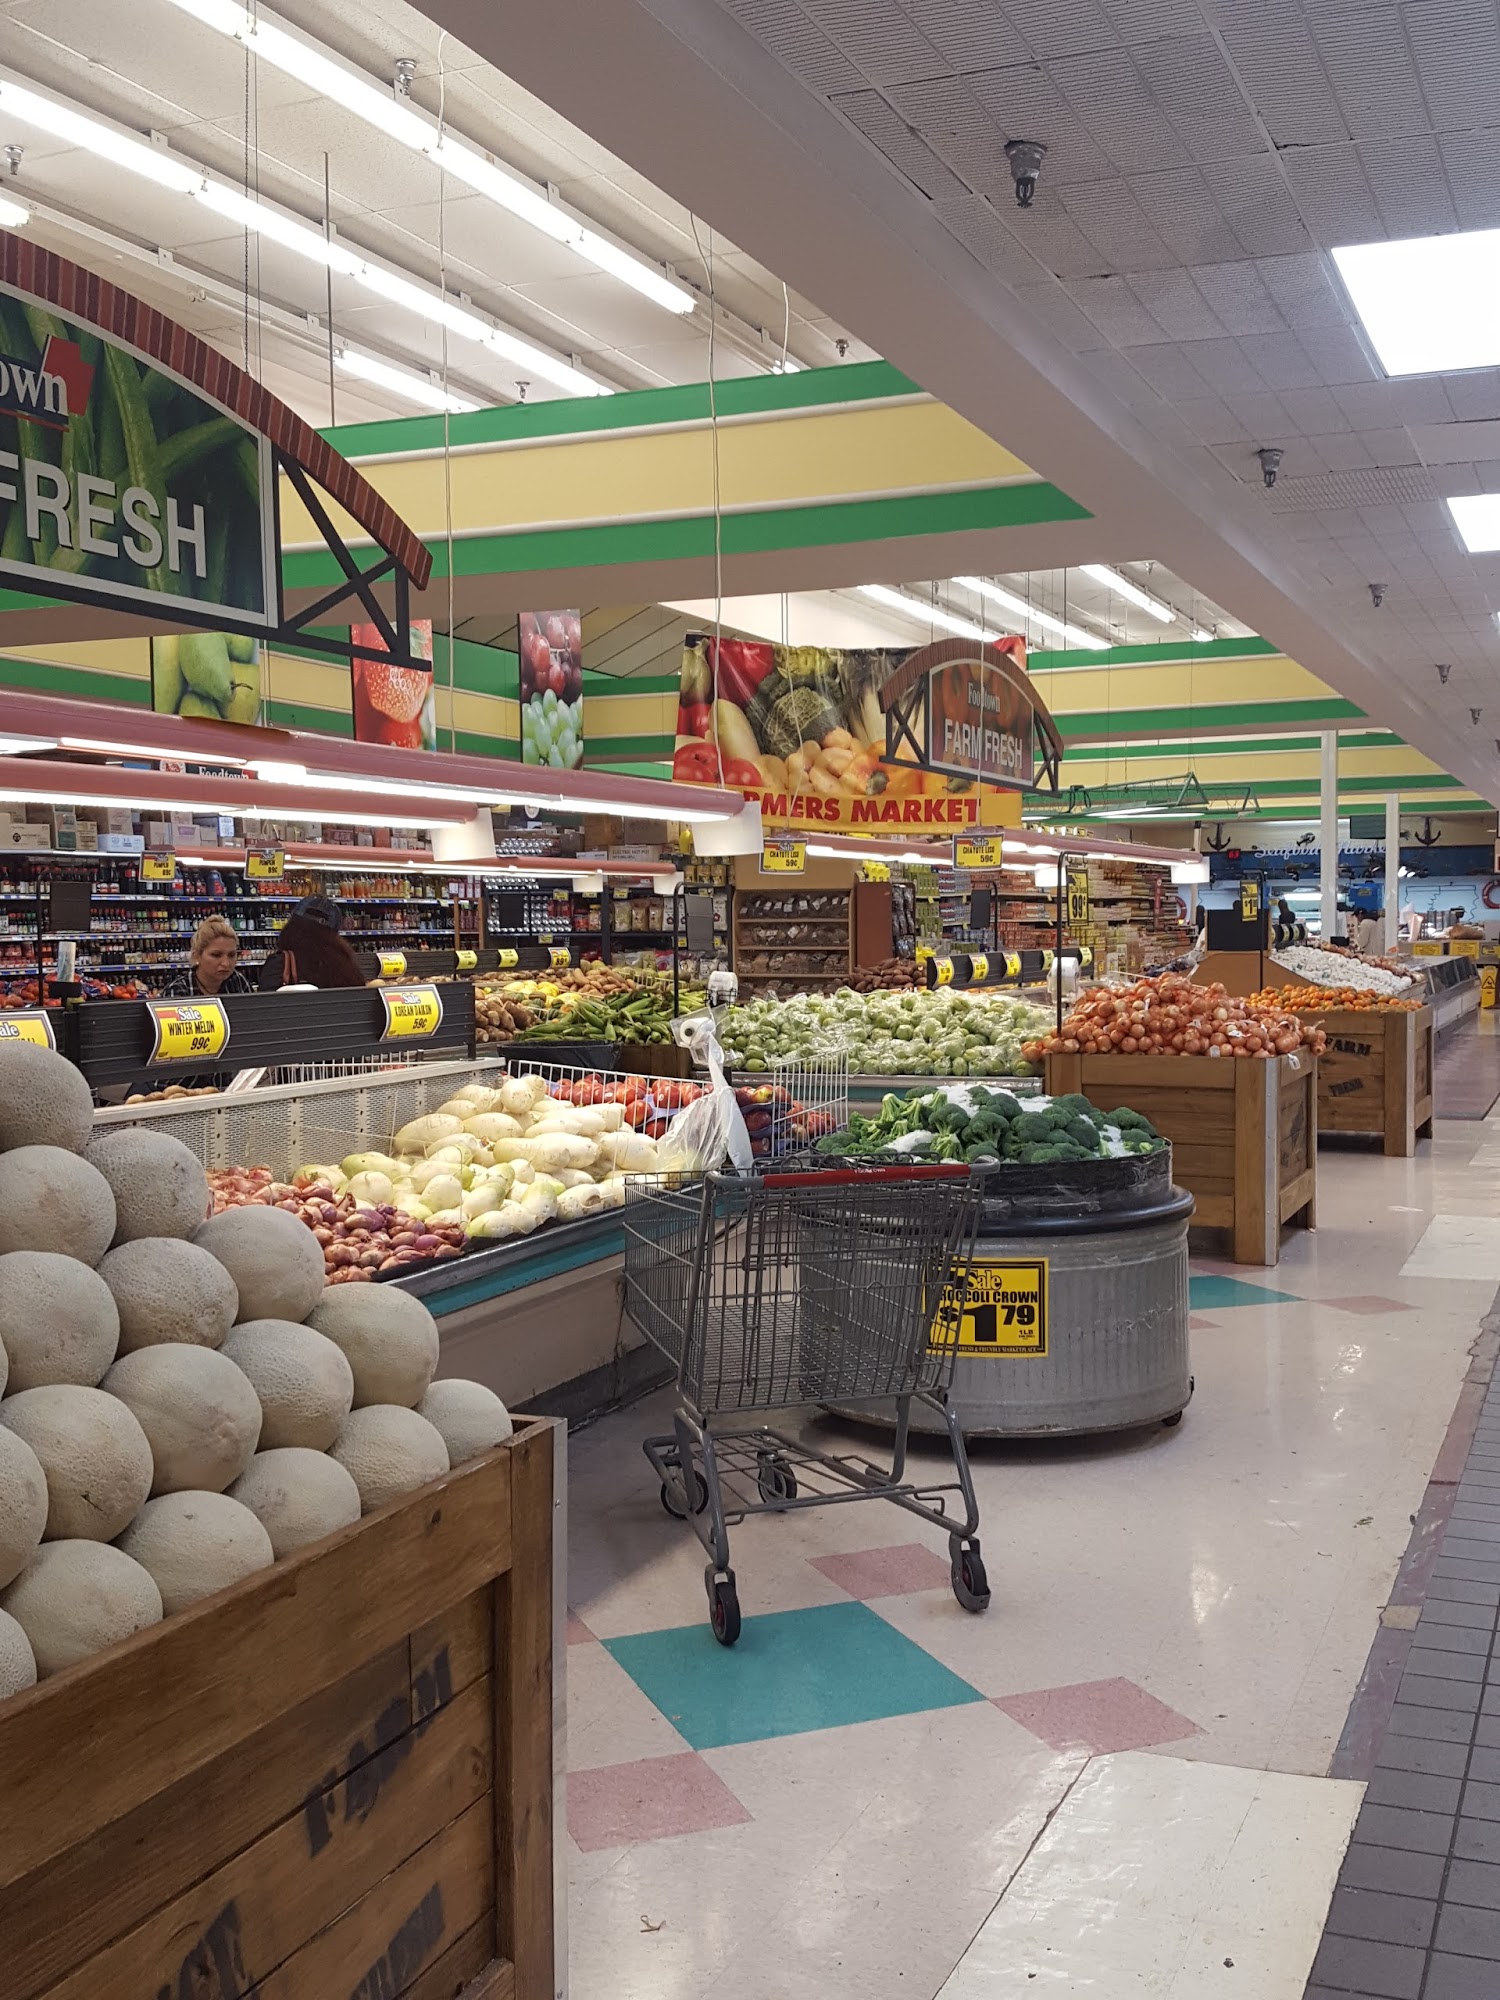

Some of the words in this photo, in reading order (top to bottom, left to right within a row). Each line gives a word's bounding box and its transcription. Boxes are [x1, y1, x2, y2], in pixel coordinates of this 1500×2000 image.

[945, 718, 981, 760] FARM
[984, 729, 1023, 770] FRESH
[851, 799, 981, 823] MARKET
[1254, 842, 1321, 860] Seafood
[402, 992, 421, 1004] Sale
[177, 1007, 202, 1021] Sale
[168, 1022, 194, 1036] WINTER
[194, 1020, 215, 1034] MELON
[968, 1270, 1002, 1290] Sale
[993, 1290, 1038, 1304] CROWN
